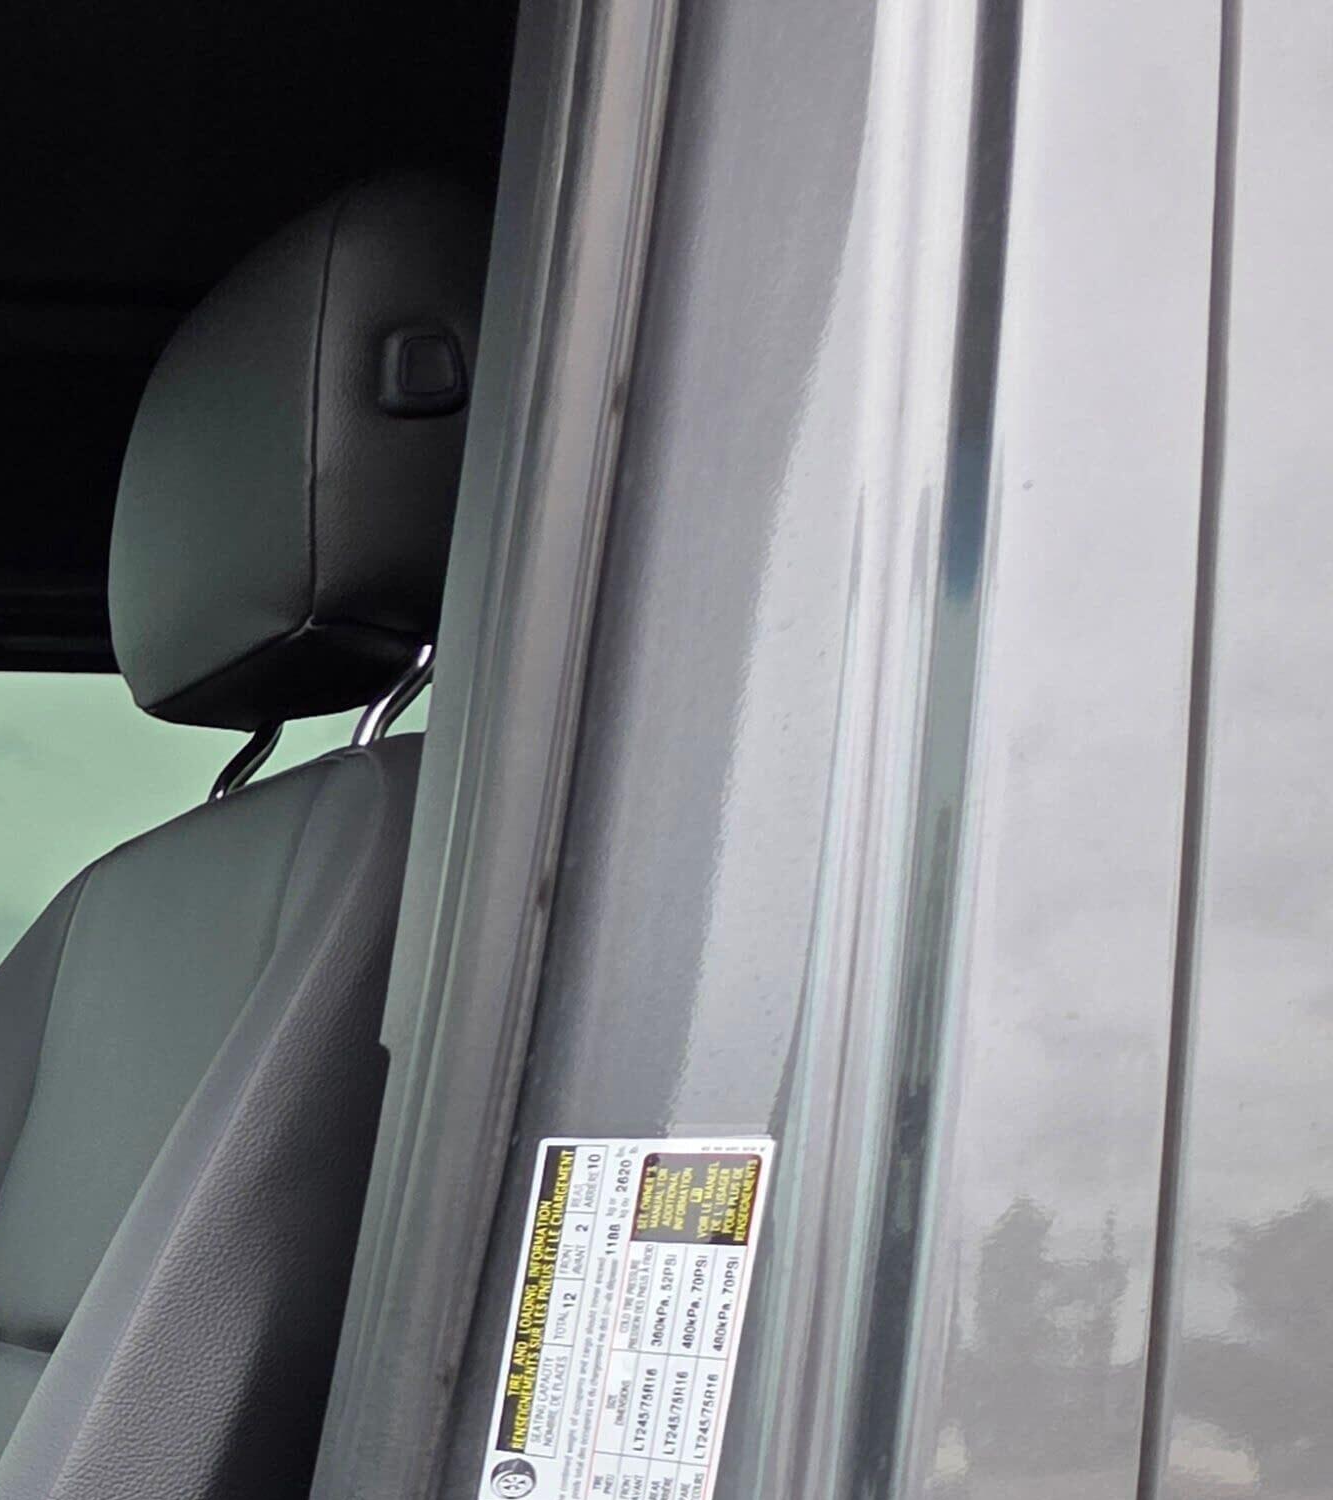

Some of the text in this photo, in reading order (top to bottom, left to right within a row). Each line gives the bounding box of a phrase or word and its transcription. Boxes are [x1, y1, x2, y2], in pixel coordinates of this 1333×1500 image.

[587, 1153, 600, 1167] 10
[616, 1160, 632, 1191] 2620
[649, 1189, 665, 1227] MANUAL
[661, 1171, 680, 1225] ADDITIONAL
[673, 1167, 694, 1229] INFORMATION
[696, 1161, 719, 1238] VOIR LE MANUEL
[722, 1208, 737, 1233] POUR
[727, 1182, 741, 1205] PLUS
[734, 1159, 758, 1241] RENSEIGNEMENTS
[710, 1219, 721, 1230] DE
[507, 1200, 552, 1395] TIRE AND LOADING INFORMATION
[511, 1150, 575, 1449] RENSEIGNEMENTS SUR LES PNEUS ET LE CHARGEMENT
[554, 1292, 577, 1339] TOTAL 12
[633, 1368, 658, 1451] LT245/75R16
[663, 1371, 689, 1455] LT245/75R16
[694, 1373, 719, 1459] LT245/75R16
